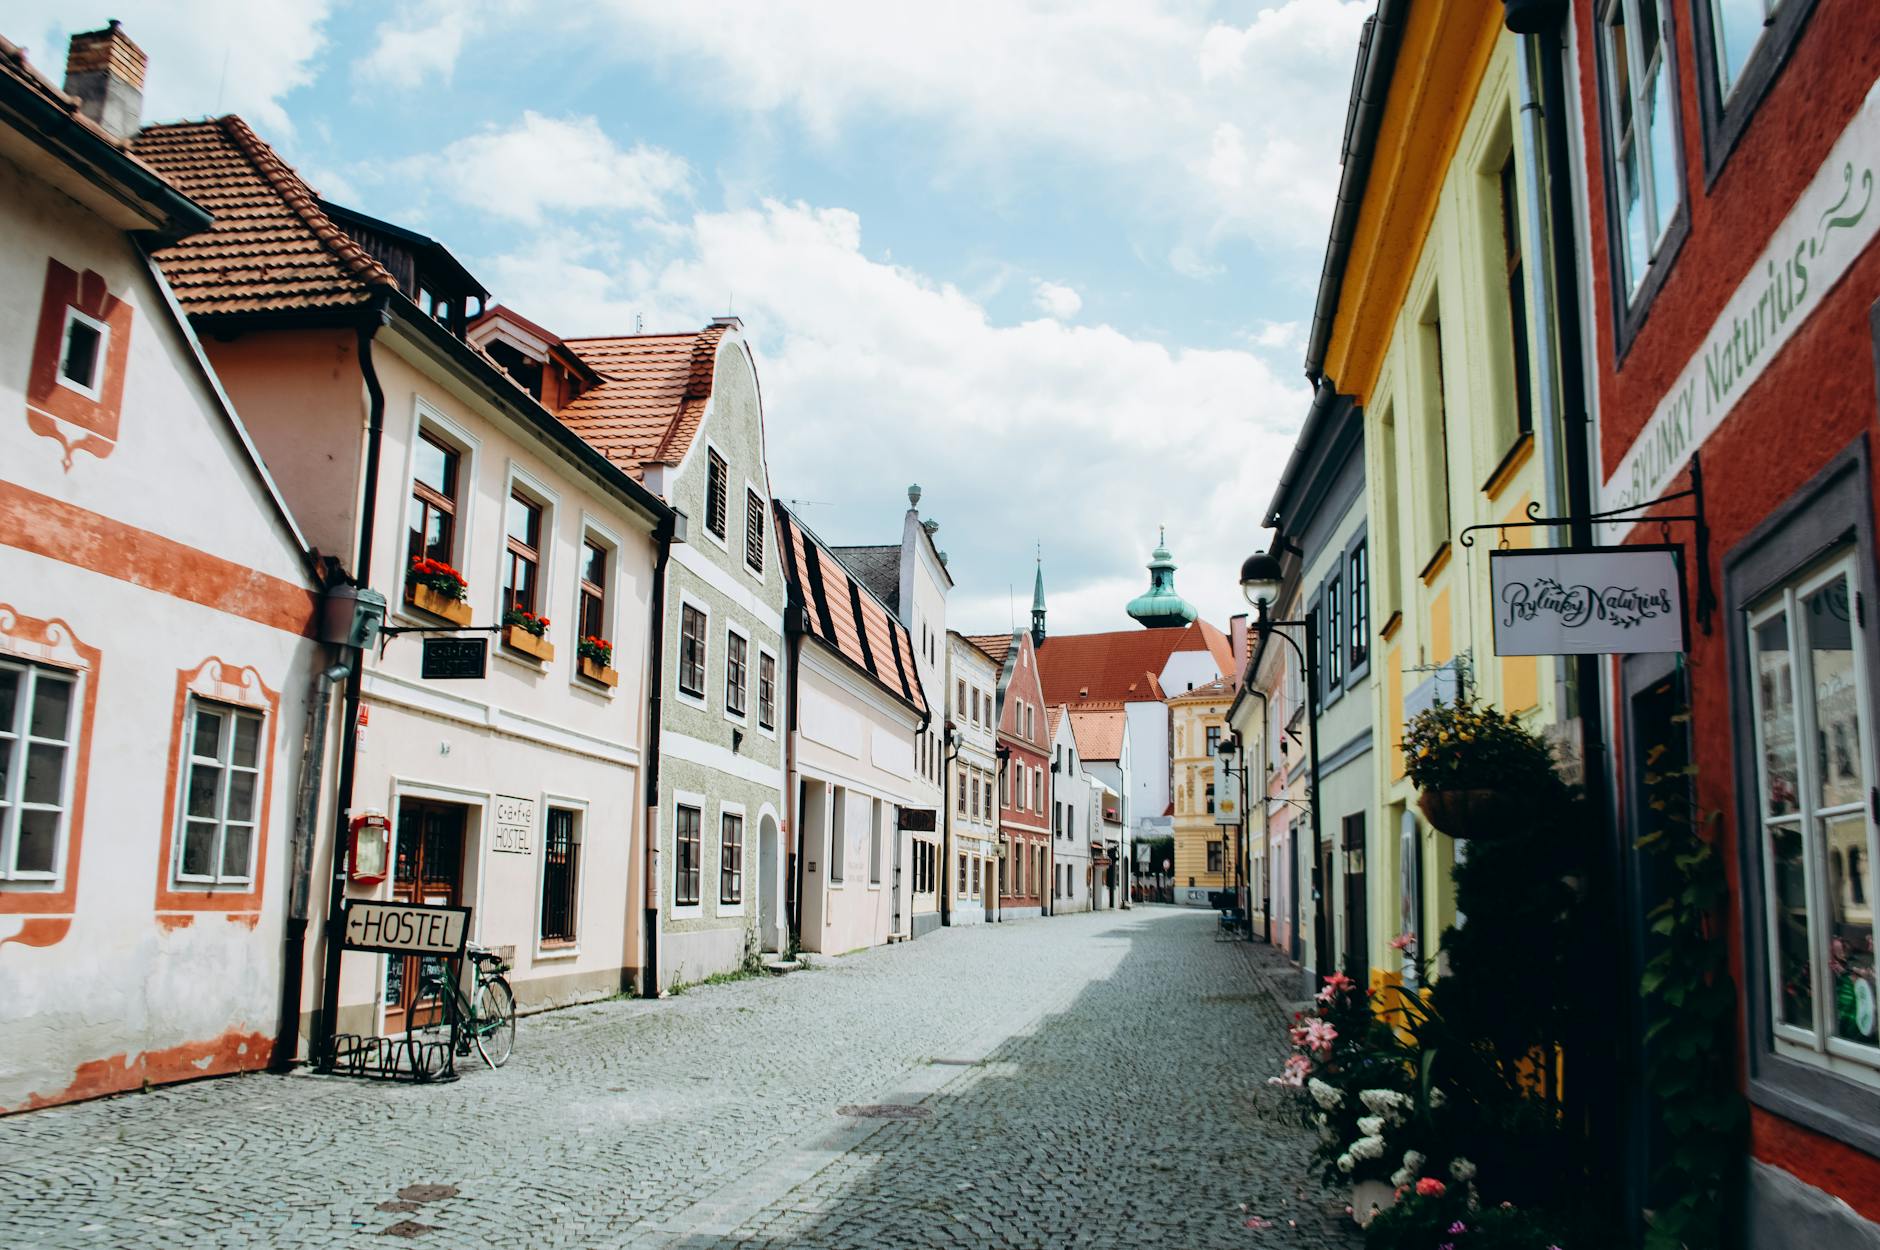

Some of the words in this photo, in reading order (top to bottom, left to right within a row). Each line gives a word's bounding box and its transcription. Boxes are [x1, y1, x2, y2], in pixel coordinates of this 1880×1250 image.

[1631, 376, 1695, 507] BYLINKY
[1704, 239, 1808, 415] Naturius
[1502, 581, 1585, 628] Bylinky
[1561, 584, 1671, 628] Naturius
[495, 827, 530, 850] HOSTEL
[362, 910, 454, 947] HOSTEL
